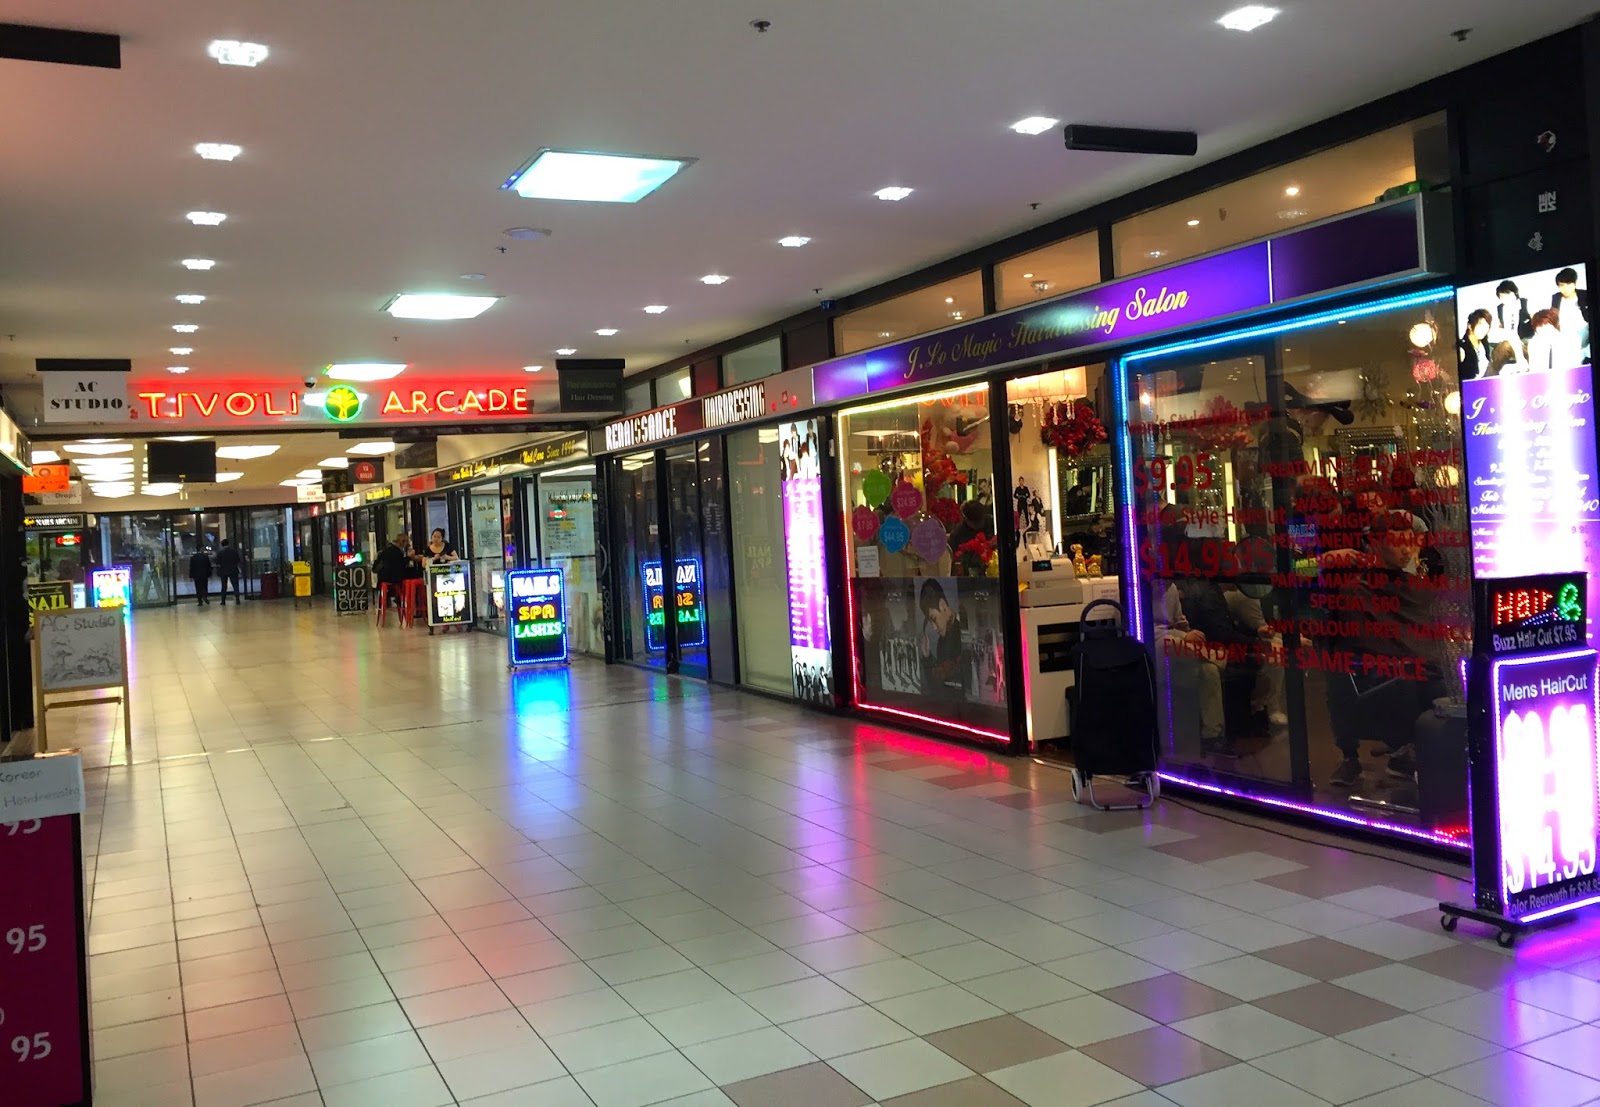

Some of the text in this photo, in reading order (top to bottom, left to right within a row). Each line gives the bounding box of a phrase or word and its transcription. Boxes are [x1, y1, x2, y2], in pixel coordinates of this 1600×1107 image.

[951, 332, 1001, 362] Magic
[1010, 306, 1120, 348] Hairdressing
[1125, 286, 1189, 321] Salon
[75, 381, 98, 393] AC
[50, 398, 123, 410] STUDIO
[138, 388, 528, 418] TIVOLI ARCADE
[704, 384, 765, 428] HAIRDRESSING
[605, 407, 678, 451] RENAISSANCE
[1134, 453, 1213, 497] $9.95
[1295, 495, 1339, 513] WASH
[1356, 491, 1404, 509] BLOW
[1182, 507, 1219, 528] Style
[1225, 506, 1285, 525] Haircut
[337, 568, 365, 588] $10
[512, 575, 561, 597] NAILS
[1270, 574, 1312, 588] PARTY
[1318, 574, 1361, 589] MAKE
[1368, 574, 1389, 589] UP
[1408, 575, 1450, 591] HAIR
[338, 589, 367, 600] BUZZ
[339, 600, 367, 610] CUT
[1310, 593, 1367, 611] SPECIAL
[518, 604, 555, 621] SPA
[1496, 589, 1553, 625] Hair
[41, 615, 69, 632] AC
[514, 622, 563, 639] LASHES
[1267, 620, 1295, 635] ANY
[1300, 620, 1360, 637] COLOUR
[1365, 622, 1399, 638] FREE
[1493, 624, 1577, 651] Buzz Hair Cut $7.95
[1164, 638, 1428, 682] EVERYDAY THE SAME PRICE
[1503, 674, 1588, 702] Mens HairCut
[1508, 899, 1527, 916] olor
[1529, 887, 1568, 910] Regrowth
[6, 924, 47, 954] 95
[11, 1032, 52, 1062] 95
